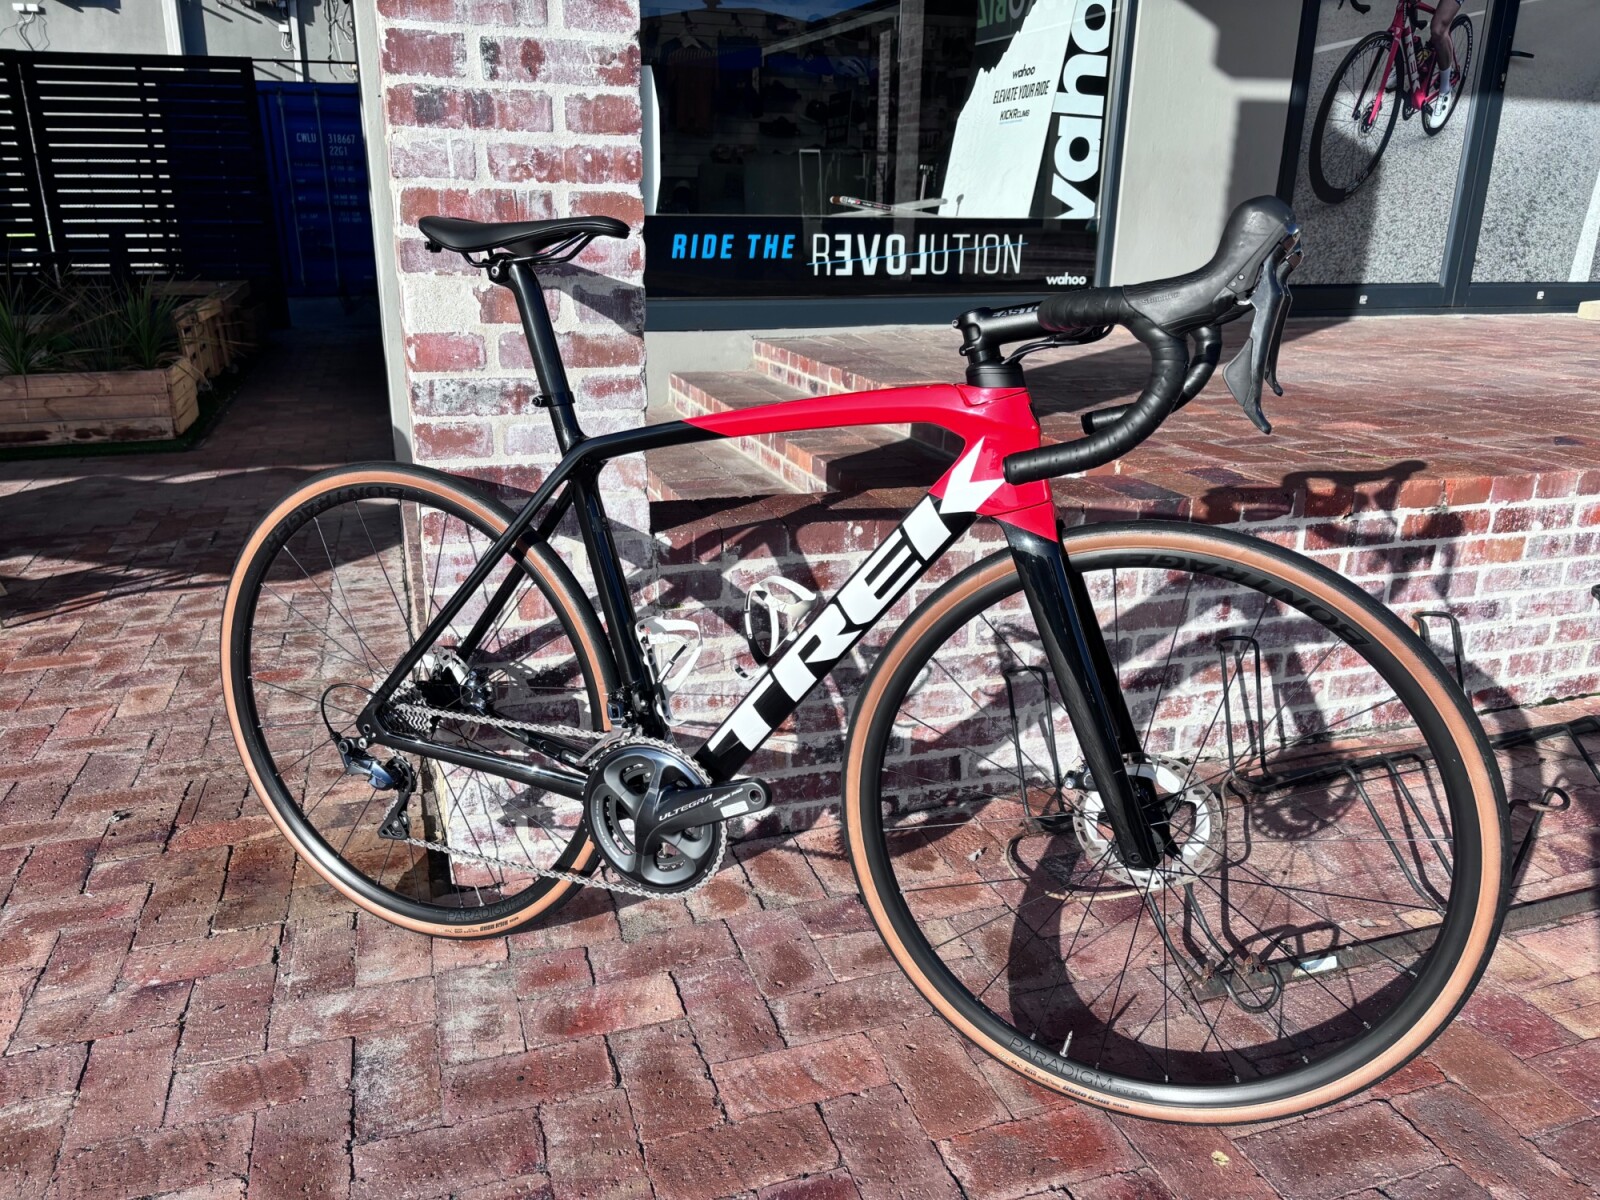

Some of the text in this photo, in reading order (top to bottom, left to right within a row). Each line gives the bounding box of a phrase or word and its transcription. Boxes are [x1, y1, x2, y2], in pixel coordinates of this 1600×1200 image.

[1012, 64, 1036, 79] wahoo
[993, 80, 1051, 104] ELEVATE YOUR RIDE
[296, 132, 356, 145] CWLU 318667
[672, 233, 1022, 277] RIDE THE REVOLUTION
[1046, 272, 1087, 286] wahoo
[707, 436, 1006, 752] TREK
[658, 793, 714, 822] ULTEGRA
[1008, 1035, 1113, 1091] PARADIGM
